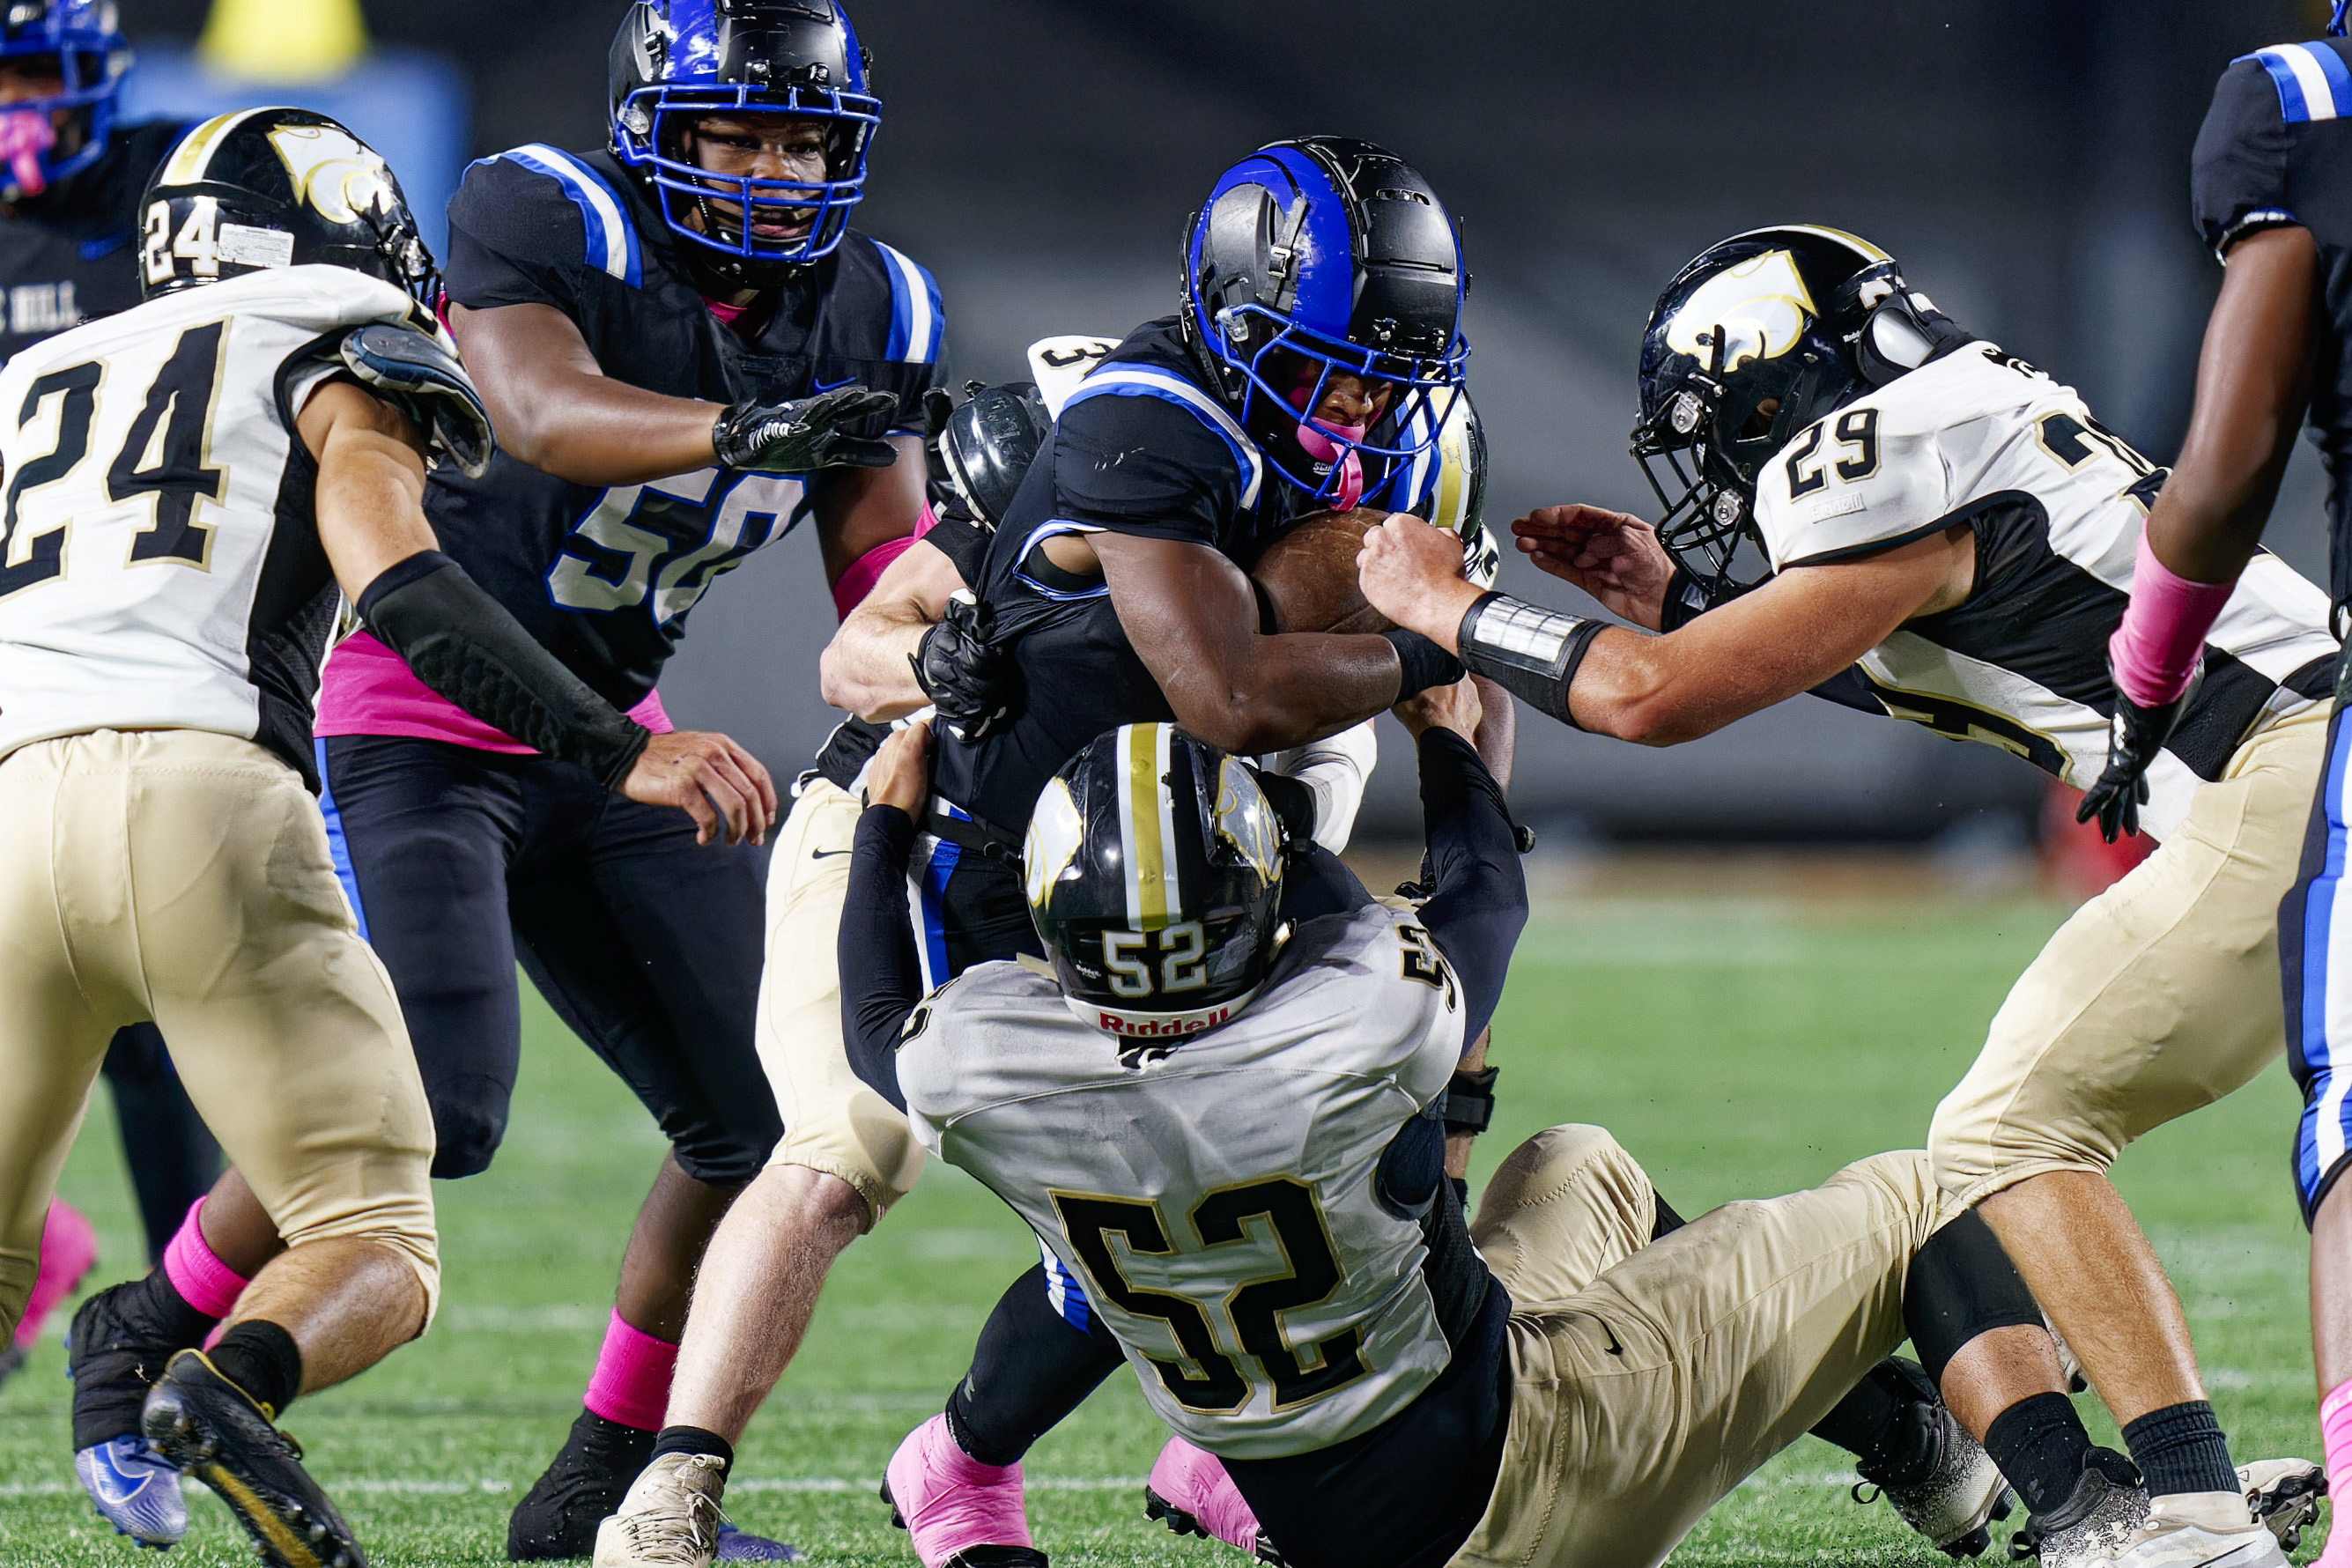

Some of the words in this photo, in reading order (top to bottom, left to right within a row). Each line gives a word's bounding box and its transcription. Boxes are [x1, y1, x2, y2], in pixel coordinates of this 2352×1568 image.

[144, 195, 219, 285] 24
[0, 314, 233, 604] 24
[1785, 407, 1882, 505] 29
[543, 465, 806, 631] 50
[1102, 921, 1206, 998] 52
[1099, 1007, 1228, 1034] Riddell
[1046, 1172, 1374, 1416] 52
